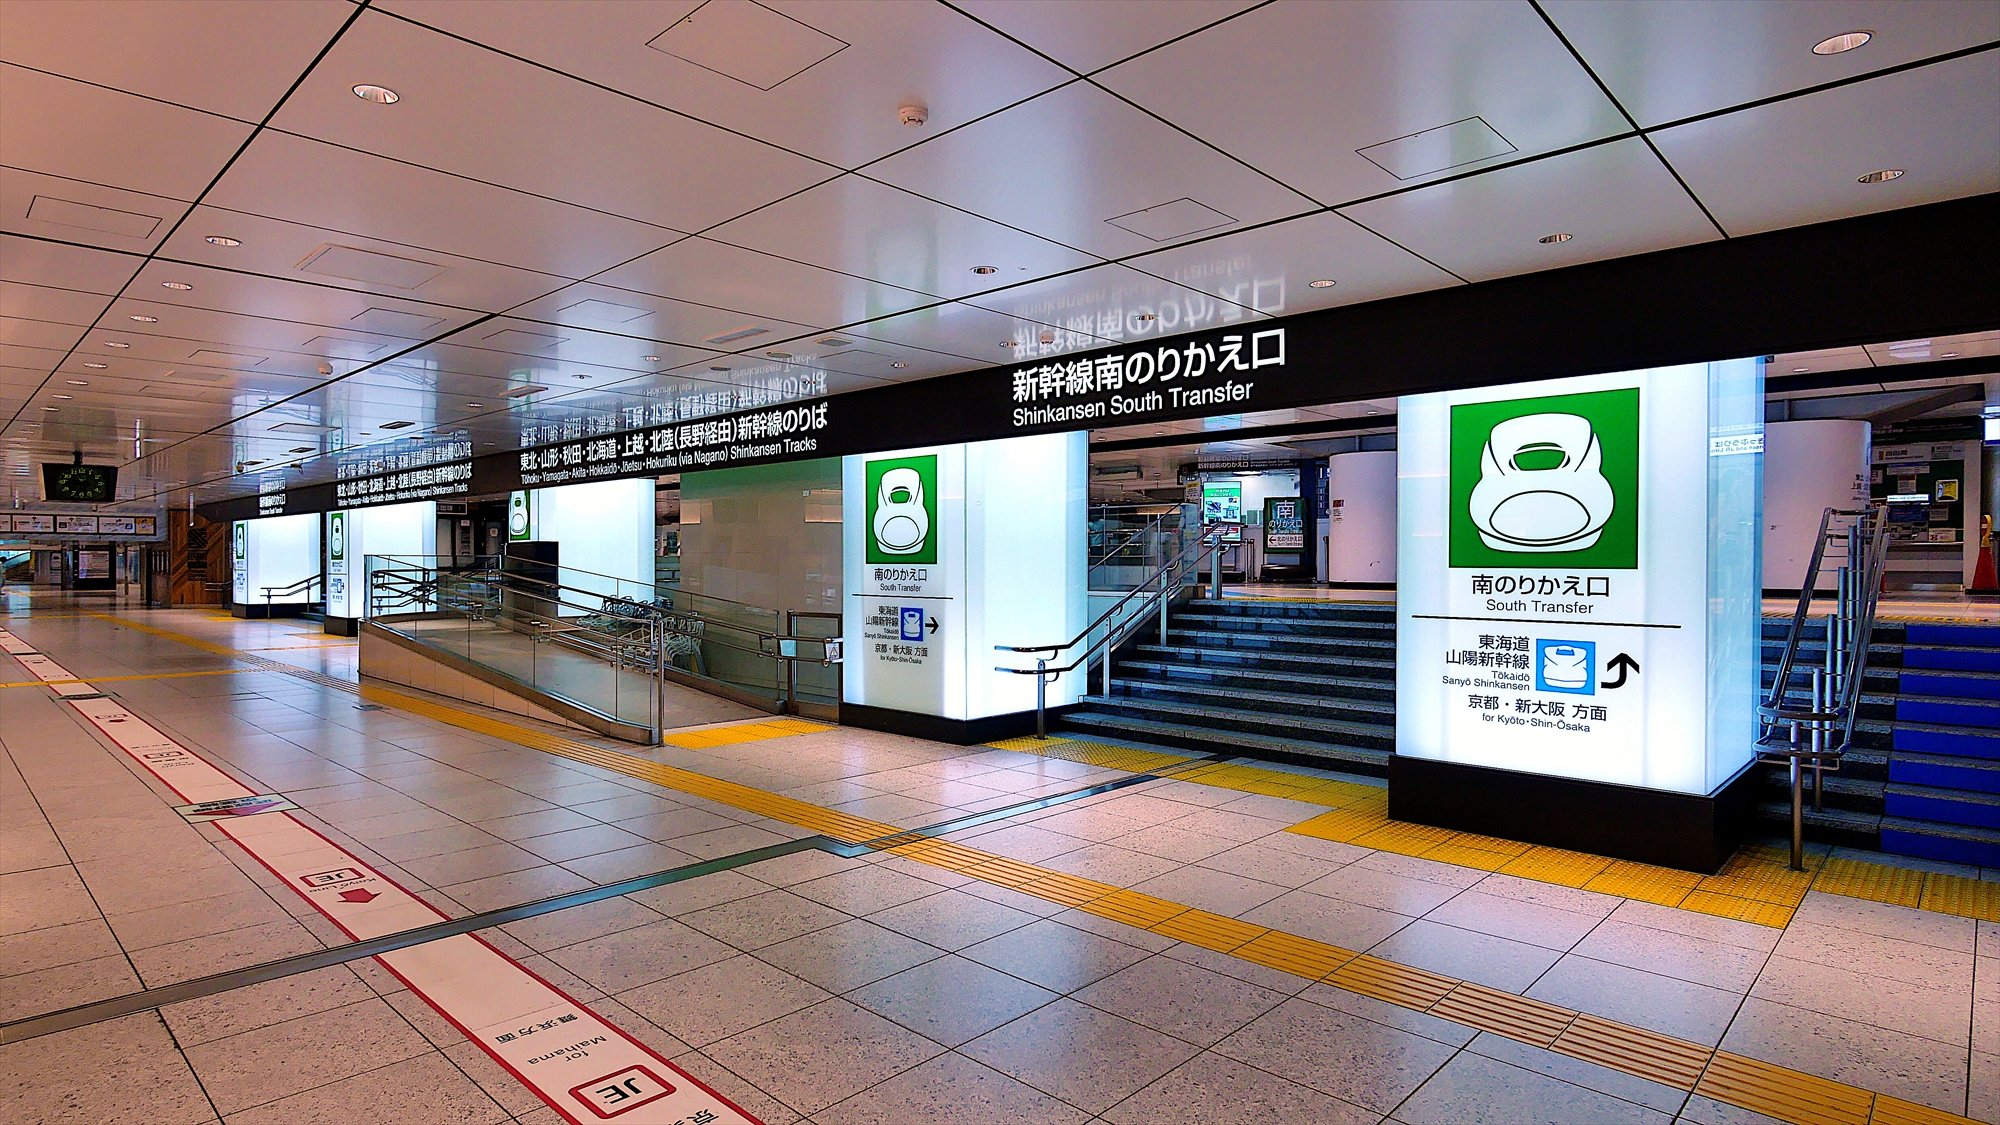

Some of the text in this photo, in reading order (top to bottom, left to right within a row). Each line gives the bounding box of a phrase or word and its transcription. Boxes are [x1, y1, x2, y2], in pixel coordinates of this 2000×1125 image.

[1013, 328, 1285, 403] 新幹線南のりかえ口
[1013, 380, 1254, 427] Shinkansen South Transfer
[678, 451, 693, 467] (via
[694, 449, 728, 467] Nagano)
[730, 443, 782, 459] Shinkansen
[784, 436, 817, 452] Tracks
[1276, 500, 1295, 518] 南
[874, 568, 927, 581] 南のりかえ口
[880, 583, 921, 592] South Transfer
[1471, 574, 1610, 597] 南のりかえ口
[1486, 599, 1594, 614] South Transfer
[1478, 635, 1530, 652] 東海道
[1445, 649, 1530, 669] 山陽新幹線
[1442, 675, 1530, 691] Sanyō Shinkansen
[1491, 670, 1530, 682] Tōkaidō
[1468, 694, 1607, 721] 京都・新大阪 方面
[1482, 712, 1495, 723] for
[315, 872, 345, 883] JE
[495, 1013, 578, 1044] 舞浜方面
[527, 1035, 608, 1066] Maihama
[565, 1050, 590, 1063] for
[595, 1077, 643, 1105] JE
